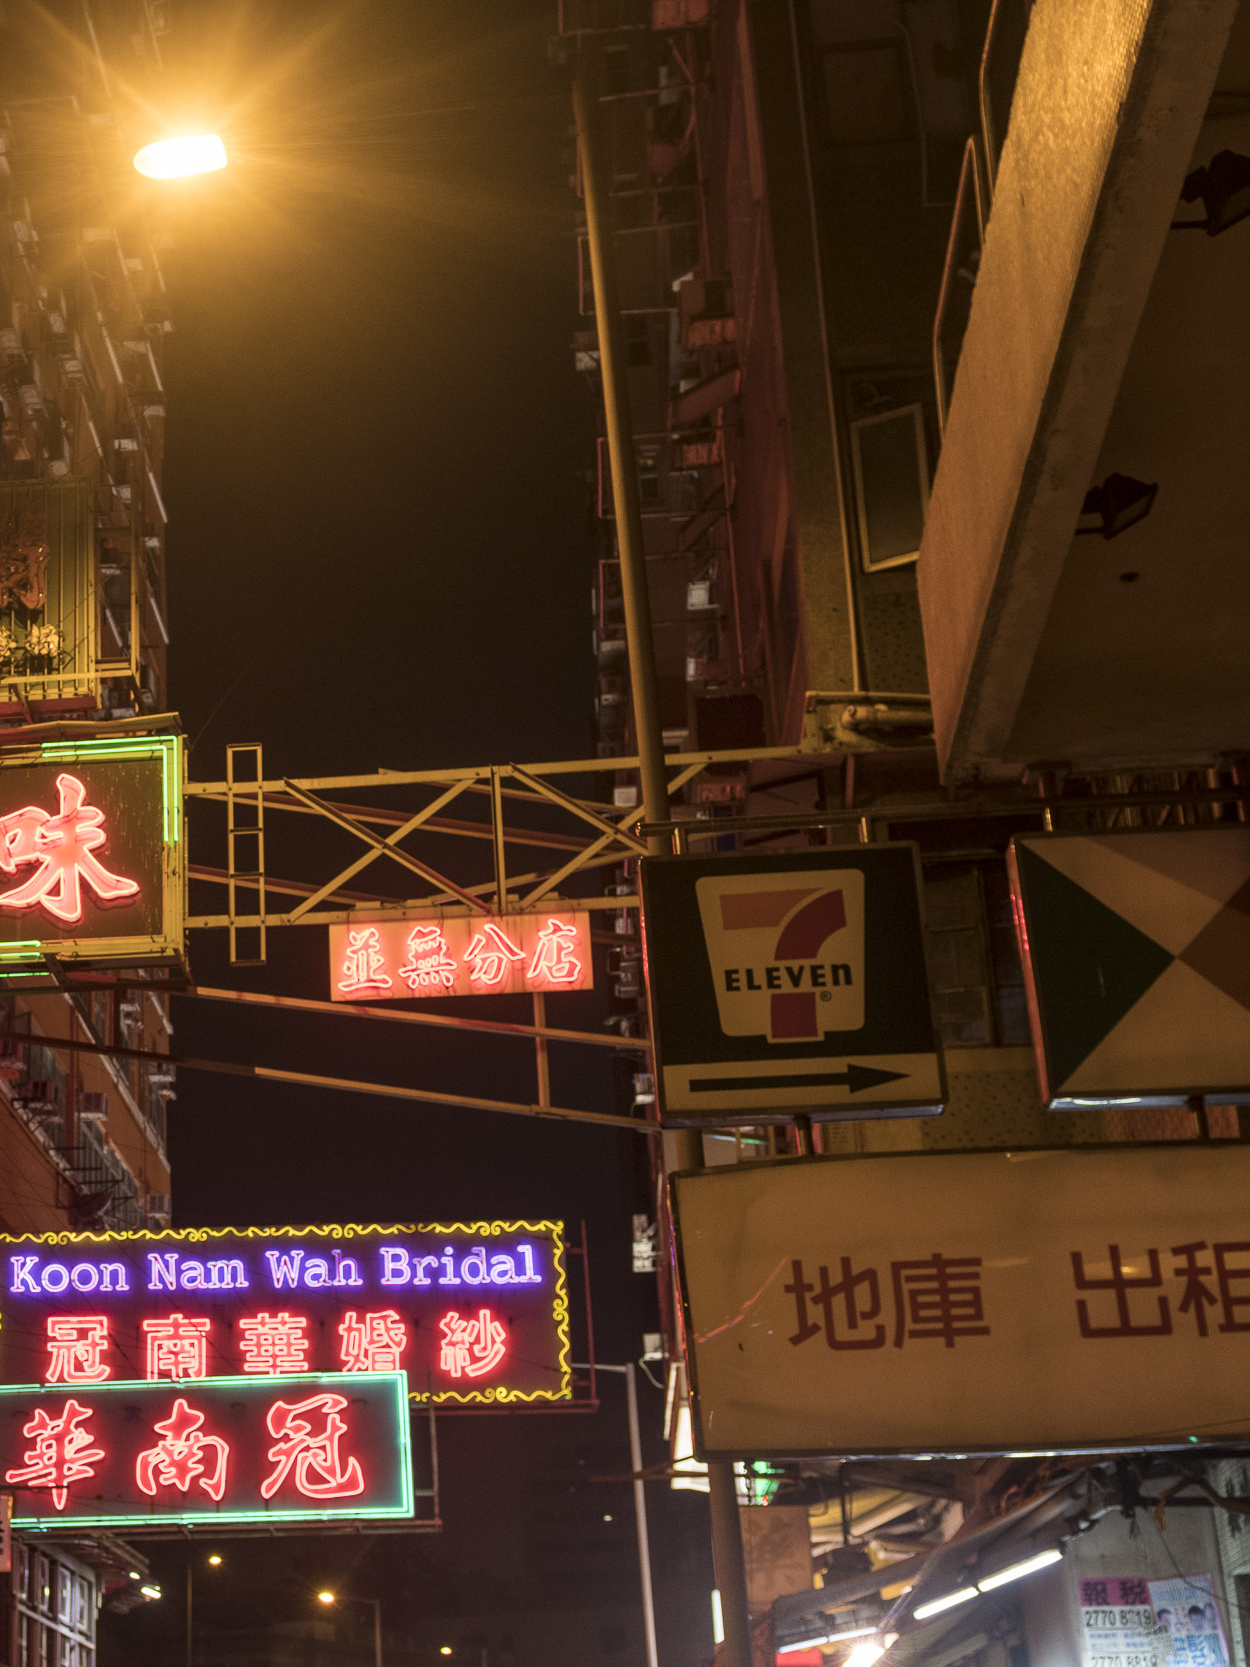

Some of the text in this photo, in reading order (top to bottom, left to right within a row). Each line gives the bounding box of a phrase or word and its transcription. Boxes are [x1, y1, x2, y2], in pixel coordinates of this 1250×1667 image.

[337, 918, 582, 992] 並無分店
[9, 1243, 542, 1294] Koon Nam Wah Bridal
[784, 1253, 991, 1351] 地庫
[45, 1308, 506, 1384] 冠南華婚紗
